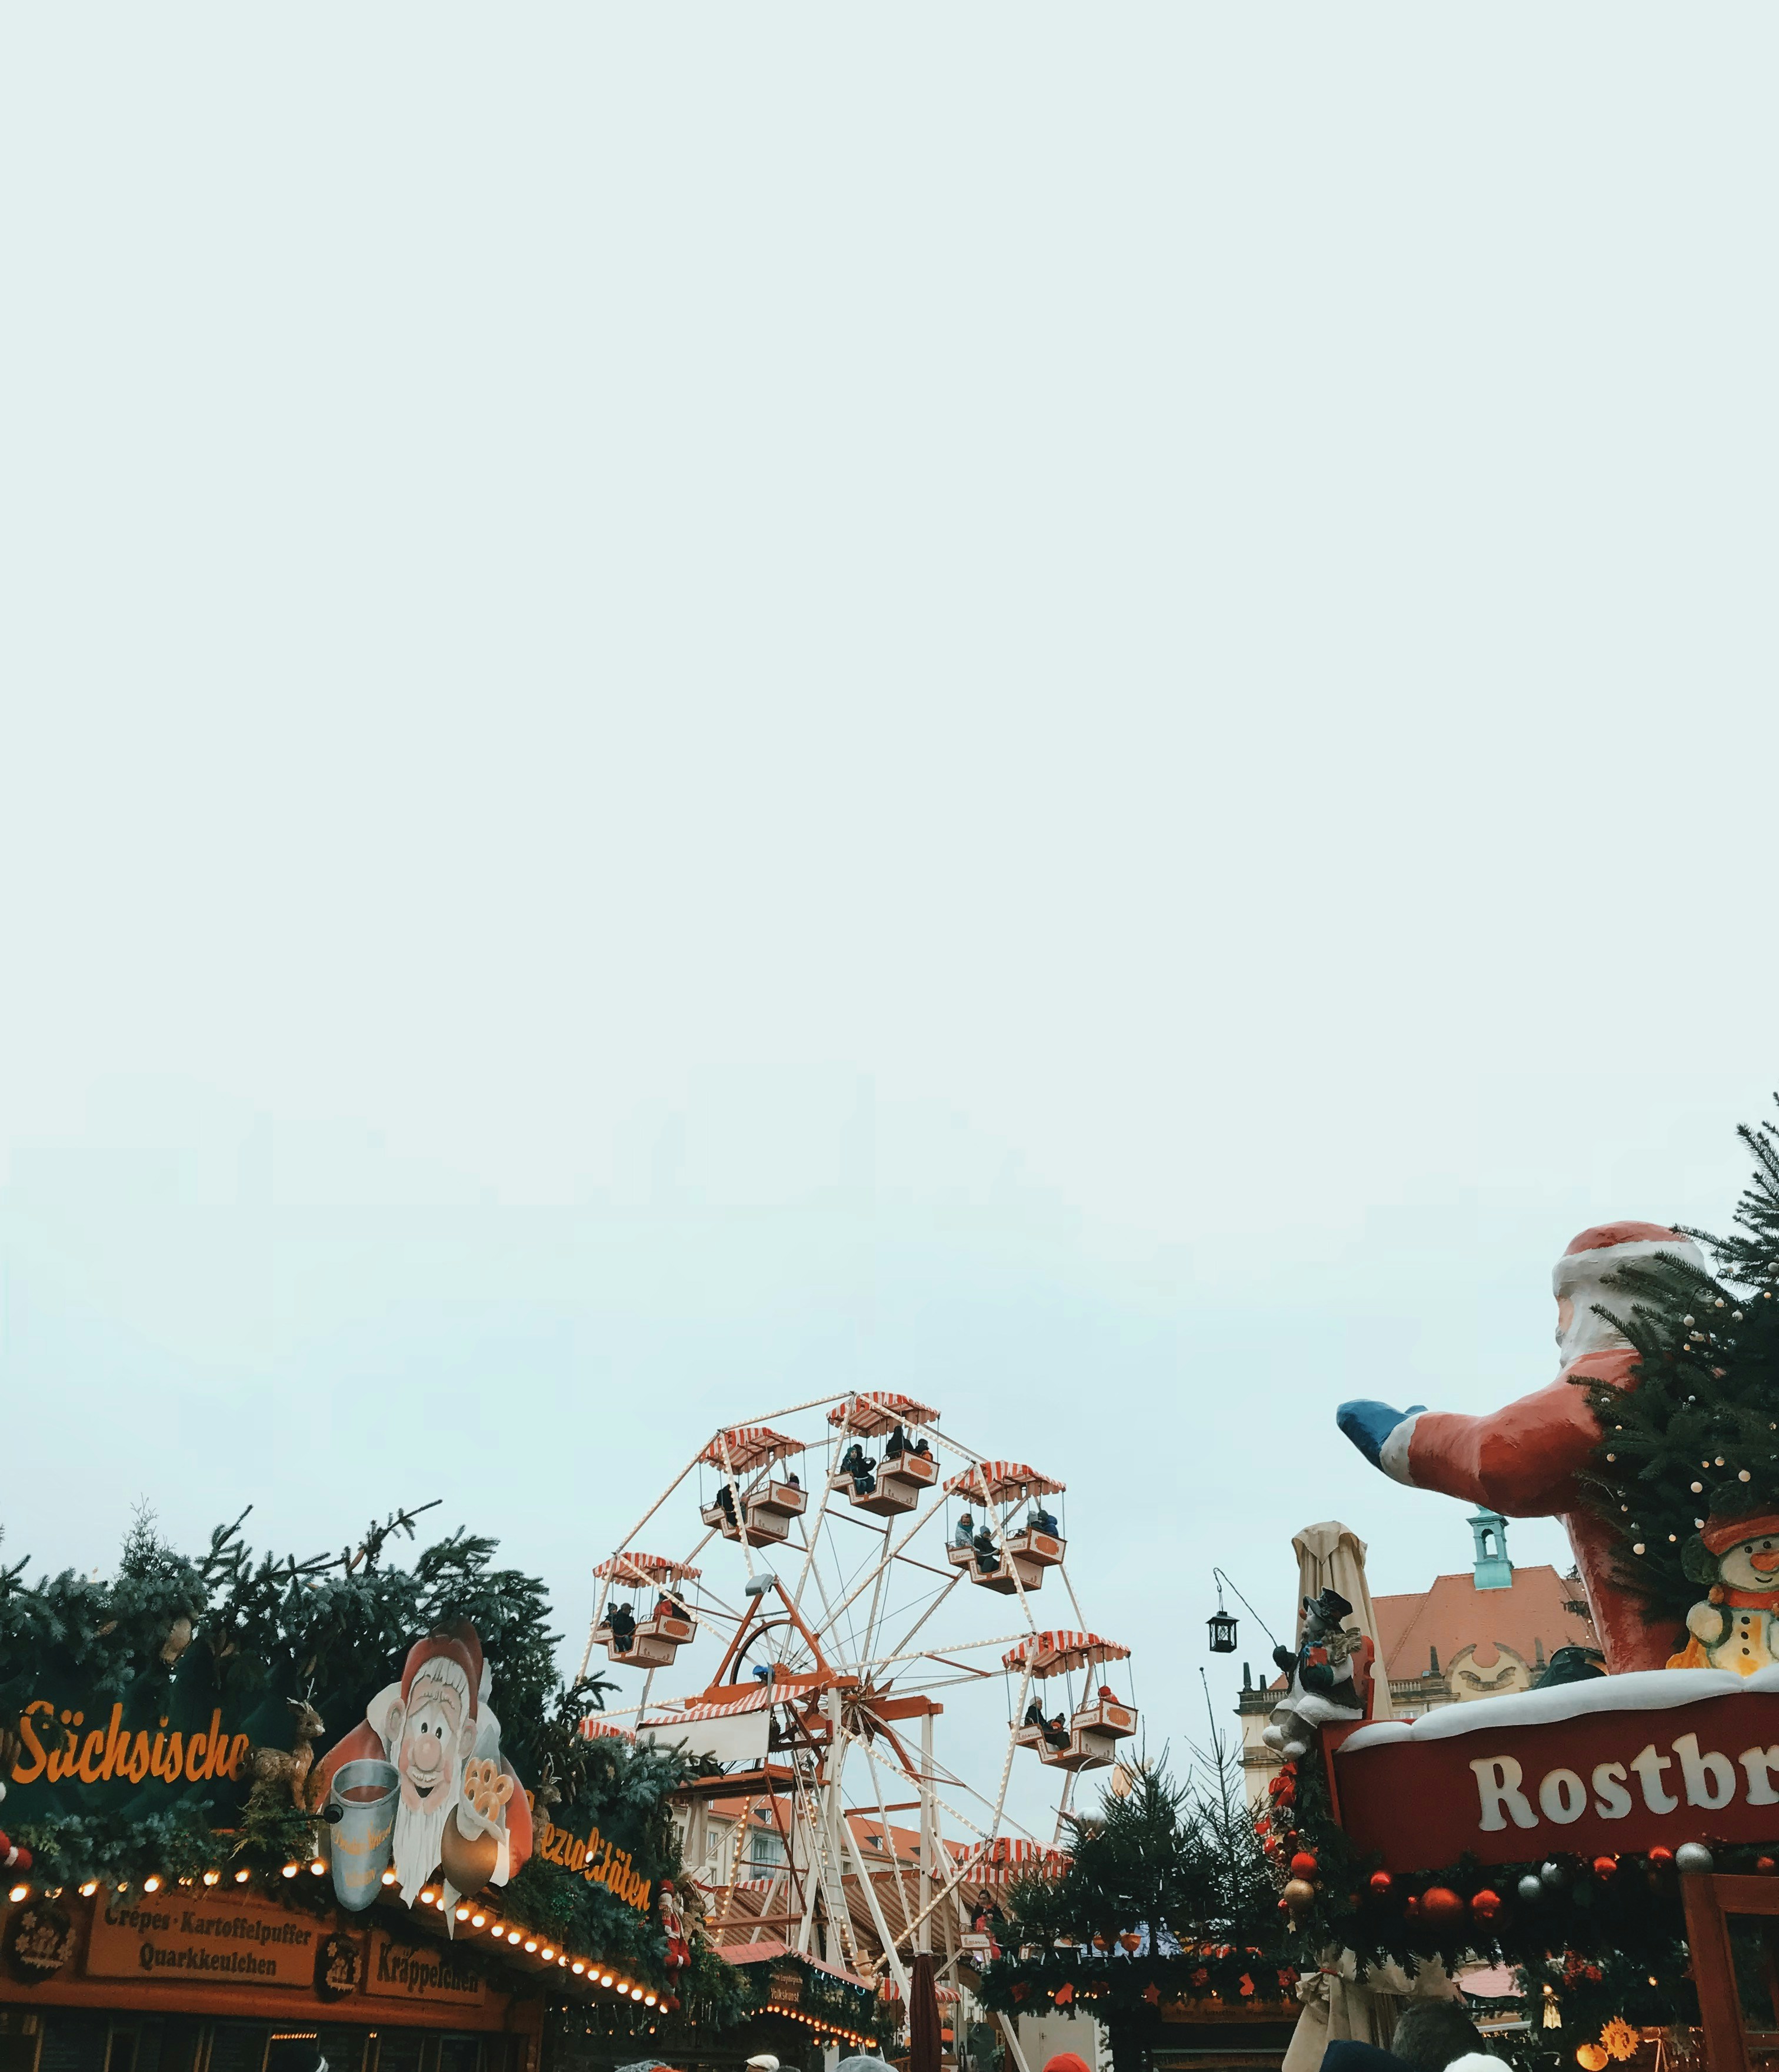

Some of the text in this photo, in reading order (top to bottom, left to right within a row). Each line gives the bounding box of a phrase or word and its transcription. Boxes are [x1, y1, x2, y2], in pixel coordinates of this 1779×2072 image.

[11, 1700, 651, 1911] Sächsische ezialitäten
[1469, 1732, 1779, 1831] Rostbr
[139, 1942, 276, 1976] Quarkkeulchen
[180, 1911, 312, 1946] Kartoffelpuffer
